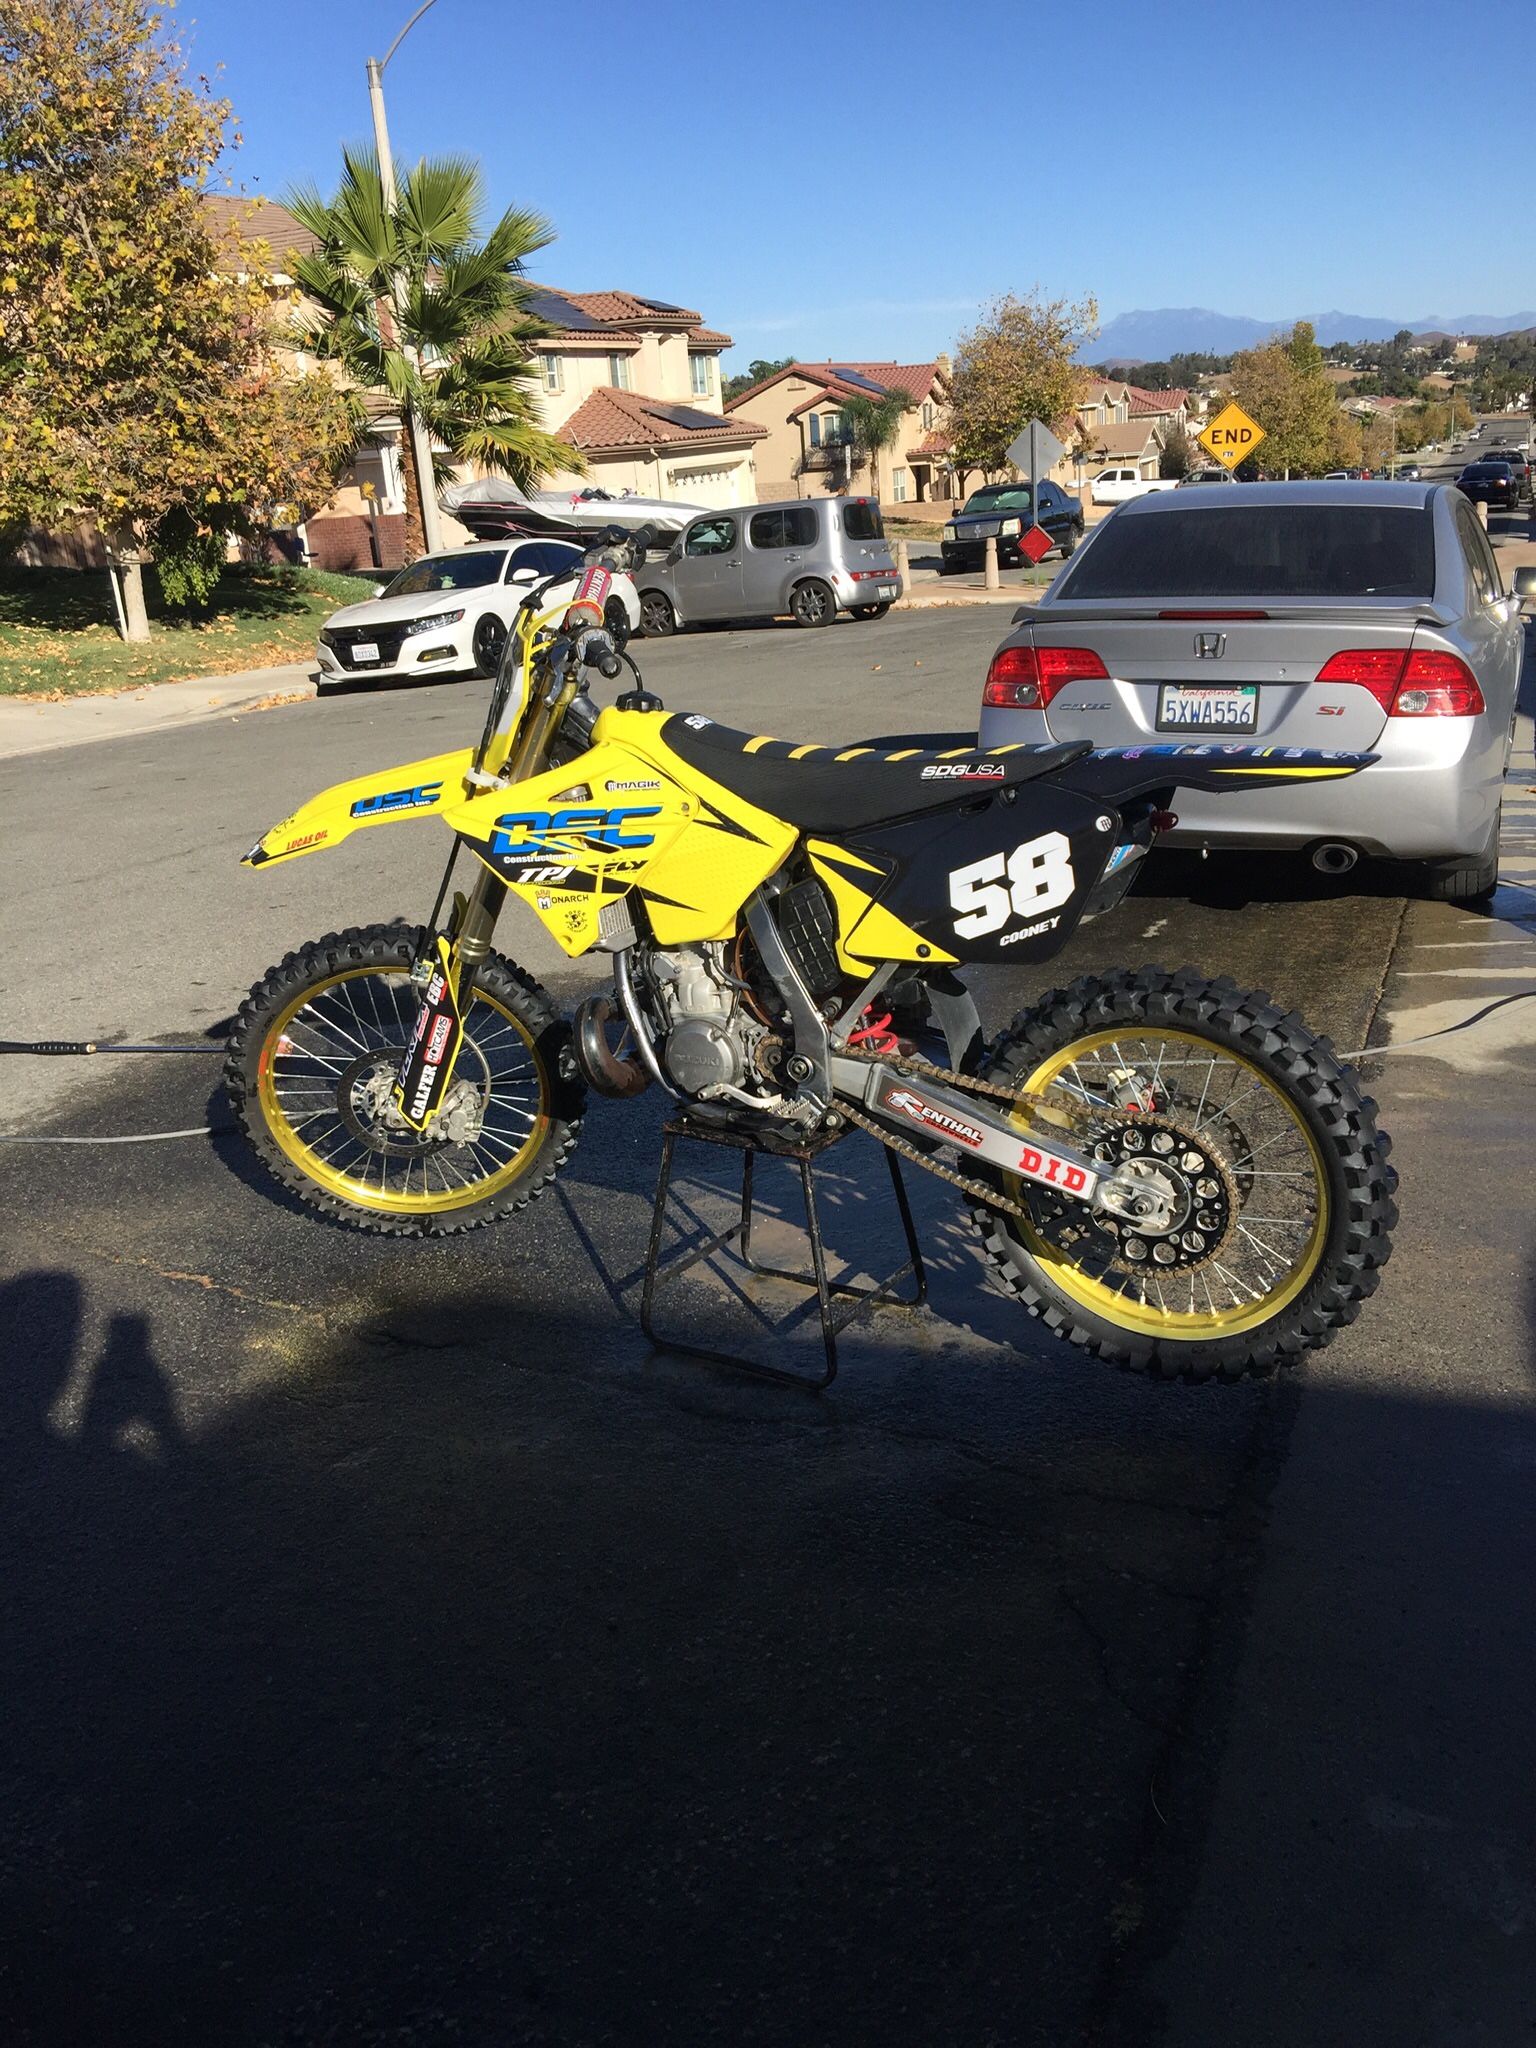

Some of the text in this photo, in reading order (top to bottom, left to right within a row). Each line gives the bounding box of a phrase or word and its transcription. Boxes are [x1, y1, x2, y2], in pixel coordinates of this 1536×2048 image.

[1211, 428, 1252, 445] END
[1166, 700, 1252, 723] 5XWA556
[352, 802, 414, 818] Construction
[286, 829, 328, 851] LUCAS OIL
[949, 831, 1076, 940] 58
[1000, 915, 1062, 947] COONEY
[426, 972, 446, 1006] EBC
[410, 1064, 438, 1120] GALFER
[888, 1091, 984, 1144] RENTHAL
